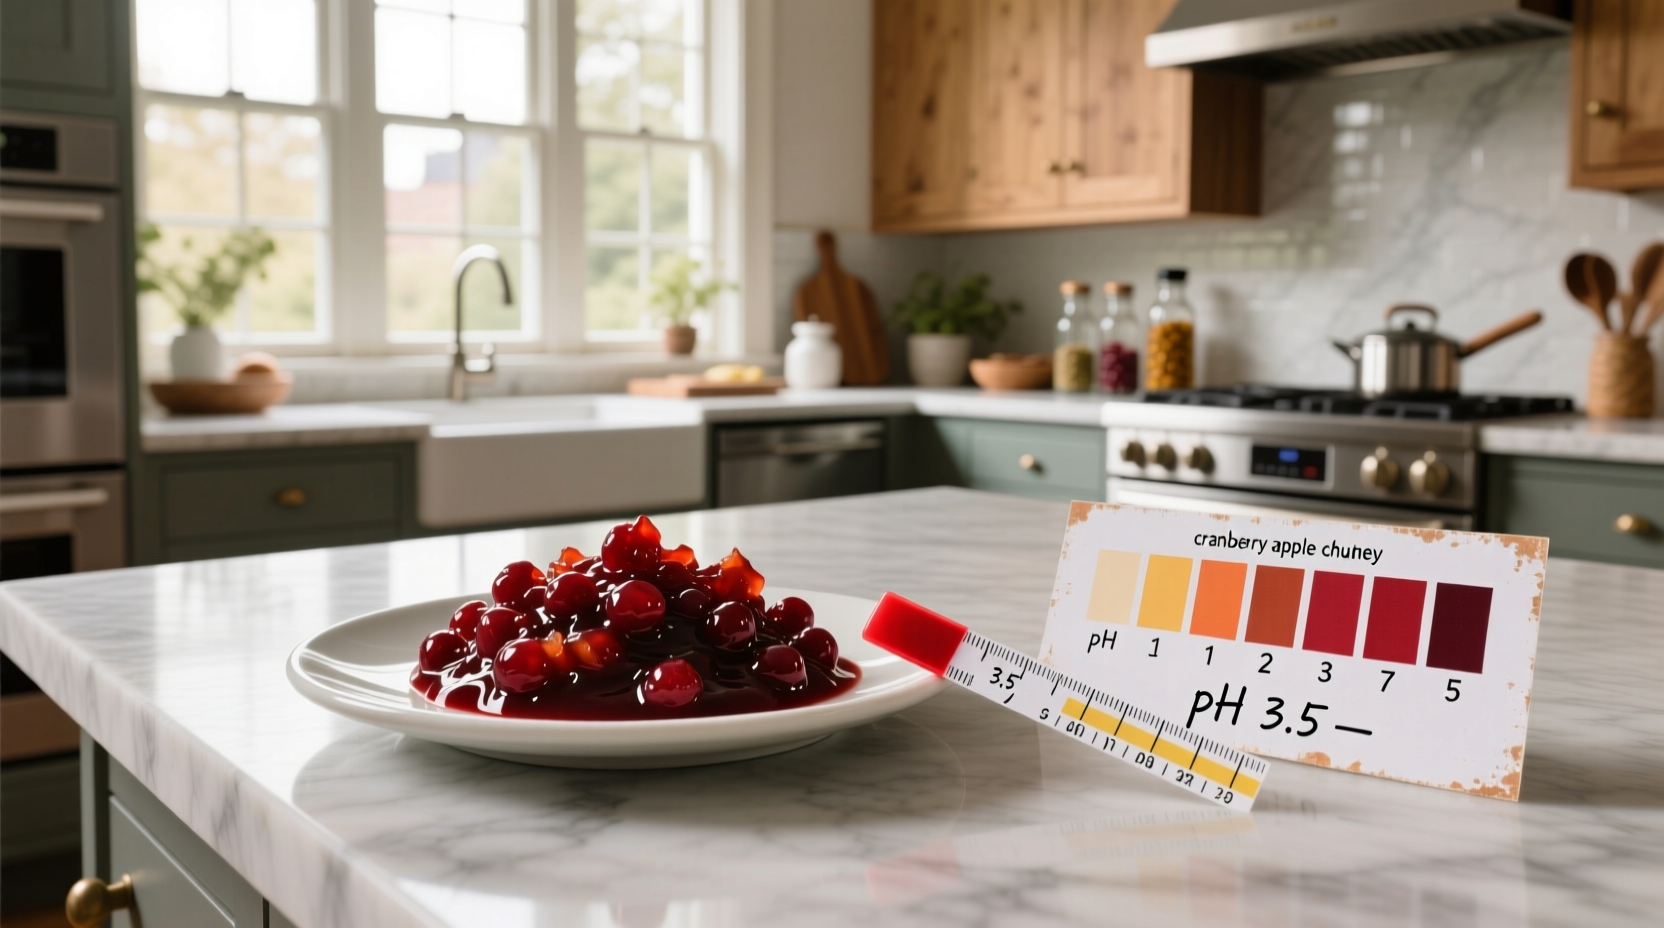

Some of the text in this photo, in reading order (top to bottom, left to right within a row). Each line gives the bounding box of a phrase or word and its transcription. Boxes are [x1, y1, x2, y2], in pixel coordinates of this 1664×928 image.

[1271, 537, 1317, 559] apple
[1088, 629, 1462, 703] pH 1 1 2 3 7 5
[1185, 682, 1248, 729] pH
[1259, 696, 1329, 737] 3.5
